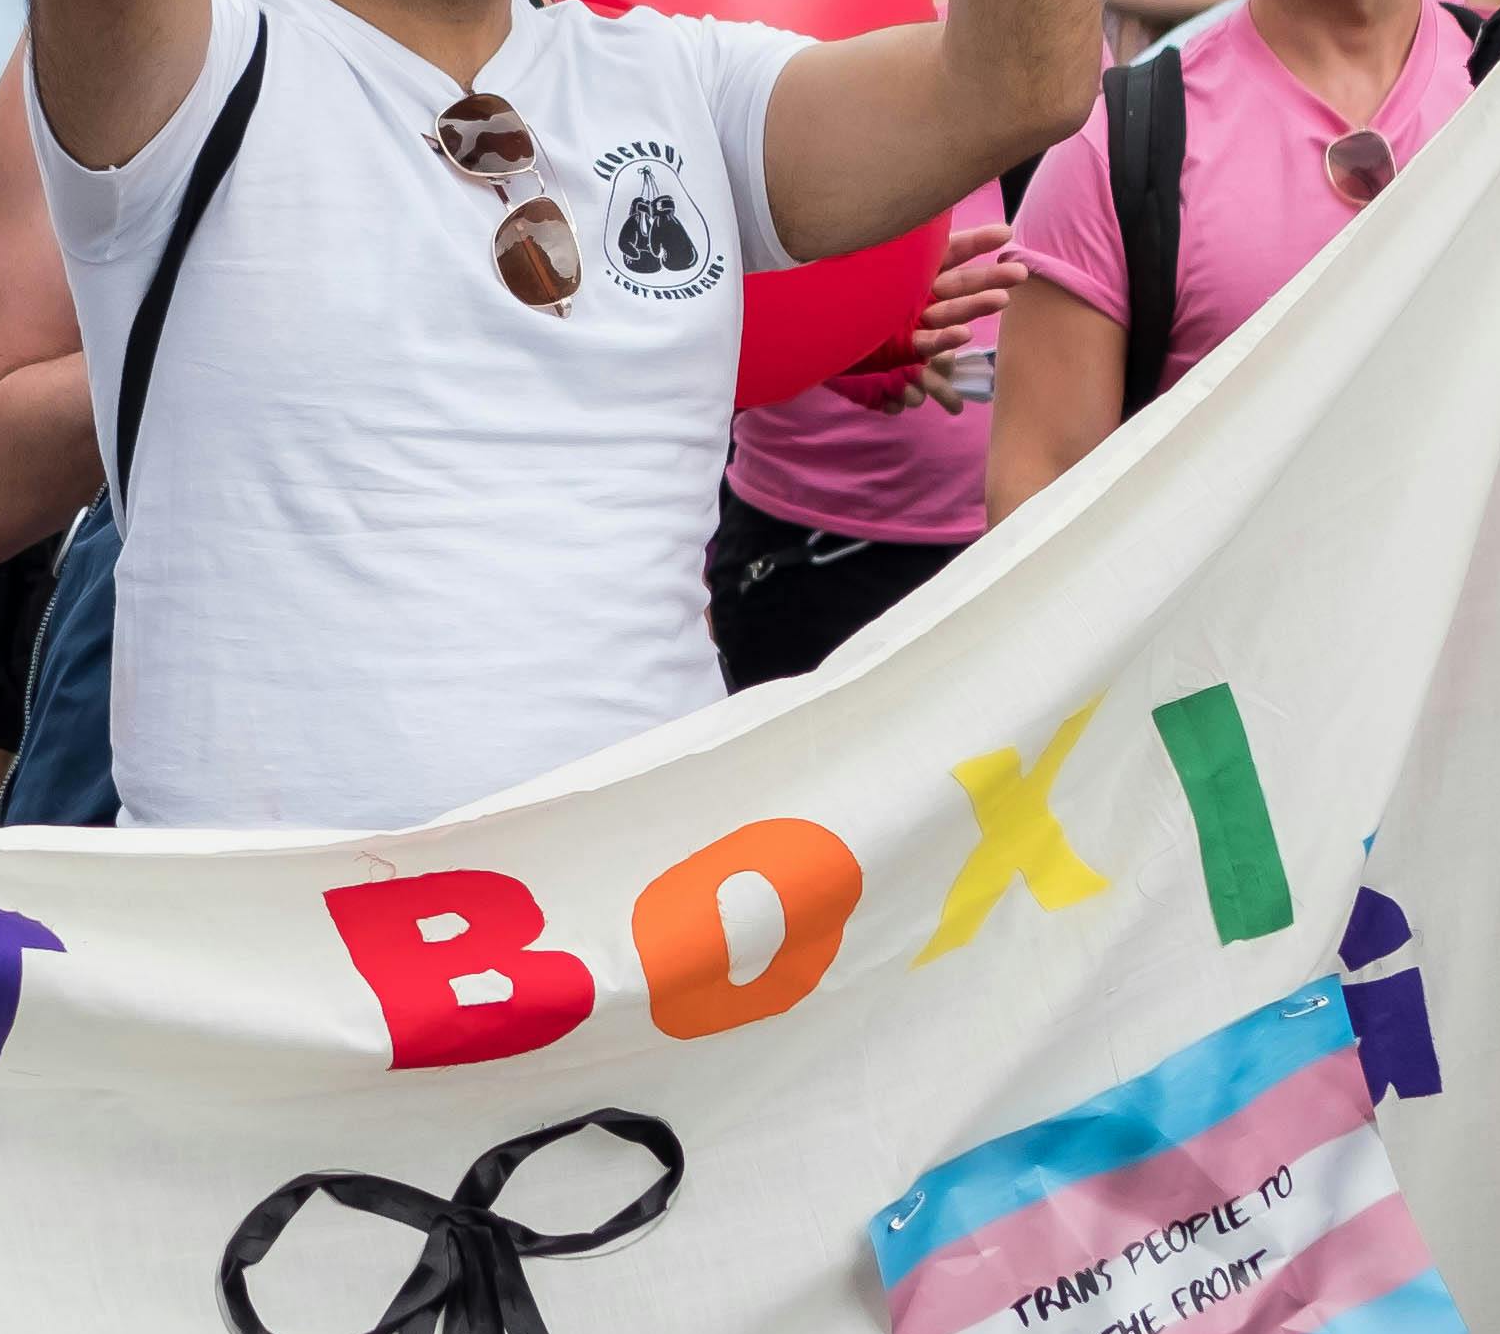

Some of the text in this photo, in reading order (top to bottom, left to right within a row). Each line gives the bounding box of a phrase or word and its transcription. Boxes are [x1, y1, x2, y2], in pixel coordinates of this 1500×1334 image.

[592, 141, 684, 182] KNOCKOUT
[1009, 1163, 1294, 1328] TRANS PEOPLE TO
[1171, 1248, 1270, 1323] FRONT
